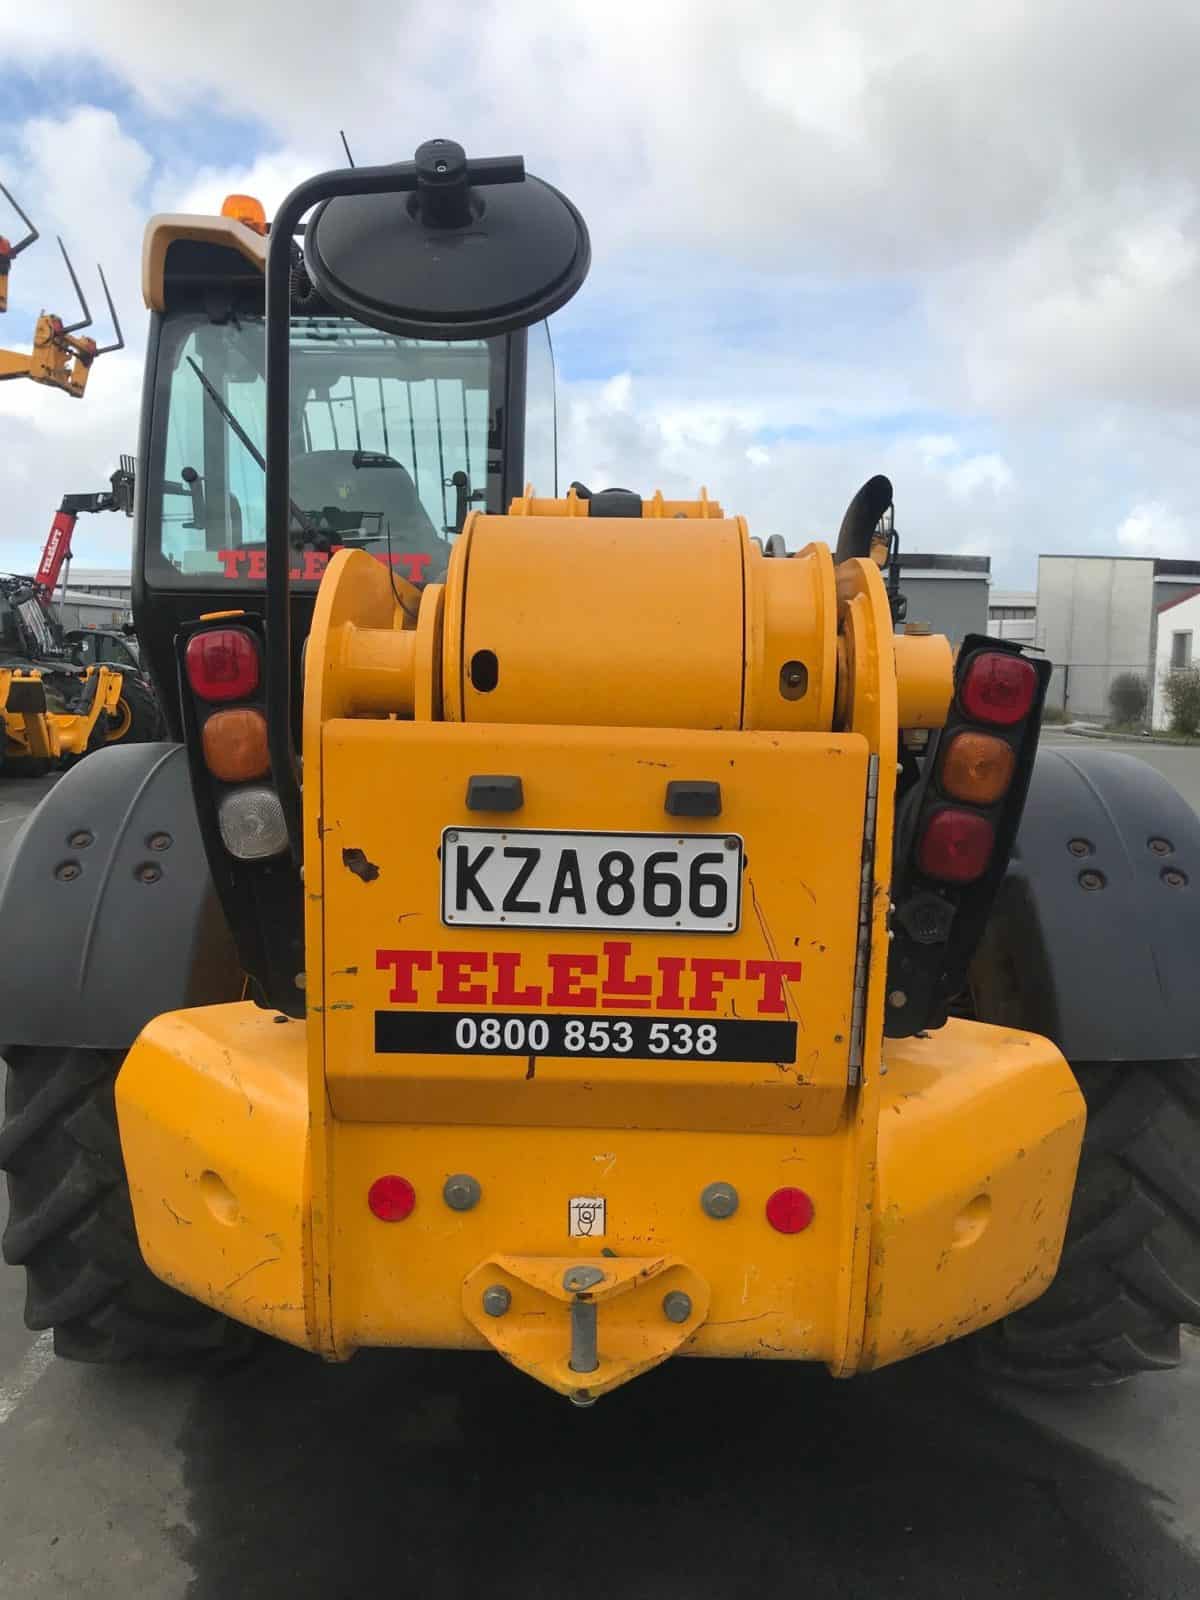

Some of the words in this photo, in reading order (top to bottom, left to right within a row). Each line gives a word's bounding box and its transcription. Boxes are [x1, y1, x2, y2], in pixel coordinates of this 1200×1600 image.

[218, 545, 432, 582] TEET
[455, 845, 728, 918] KZA866
[375, 941, 802, 1013] TELELIFT
[455, 1018, 550, 1051] 0800
[563, 1020, 634, 1053] 853
[648, 1023, 718, 1056] 538
